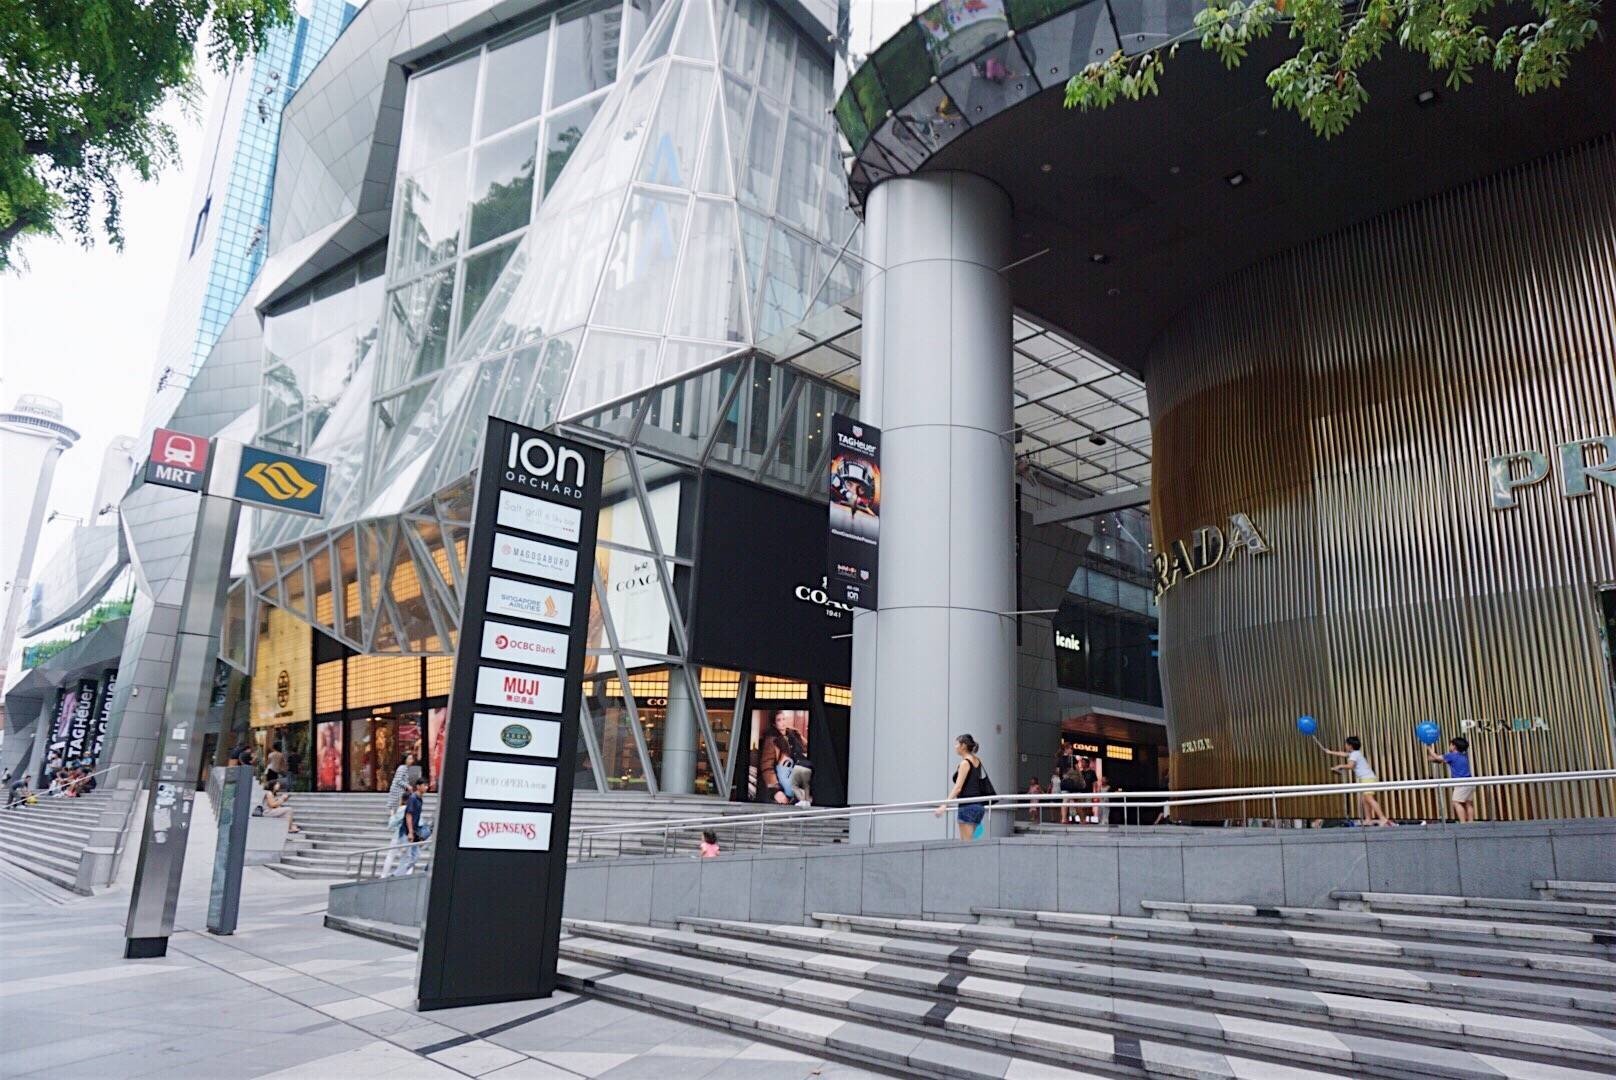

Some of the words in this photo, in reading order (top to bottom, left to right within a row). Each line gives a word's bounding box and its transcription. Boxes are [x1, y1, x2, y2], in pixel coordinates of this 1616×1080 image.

[155, 464, 196, 484] MRT
[505, 471, 583, 499] ORCHARD
[513, 547, 570, 568] MAGOSABURO
[1153, 511, 1270, 607] RADA
[616, 574, 659, 592] COAC
[501, 594, 541, 607] SINGAPORE
[509, 602, 541, 613] AIRLINES
[826, 609, 841, 618] 1941
[510, 640, 535, 652] OCBC
[536, 644, 557, 655] Bank
[504, 676, 540, 696] MUJI
[1073, 743, 1098, 753] COACH
[475, 775, 498, 787] FOOD
[500, 777, 529, 789] OPERA
[477, 821, 536, 840] SWENSEN'S
